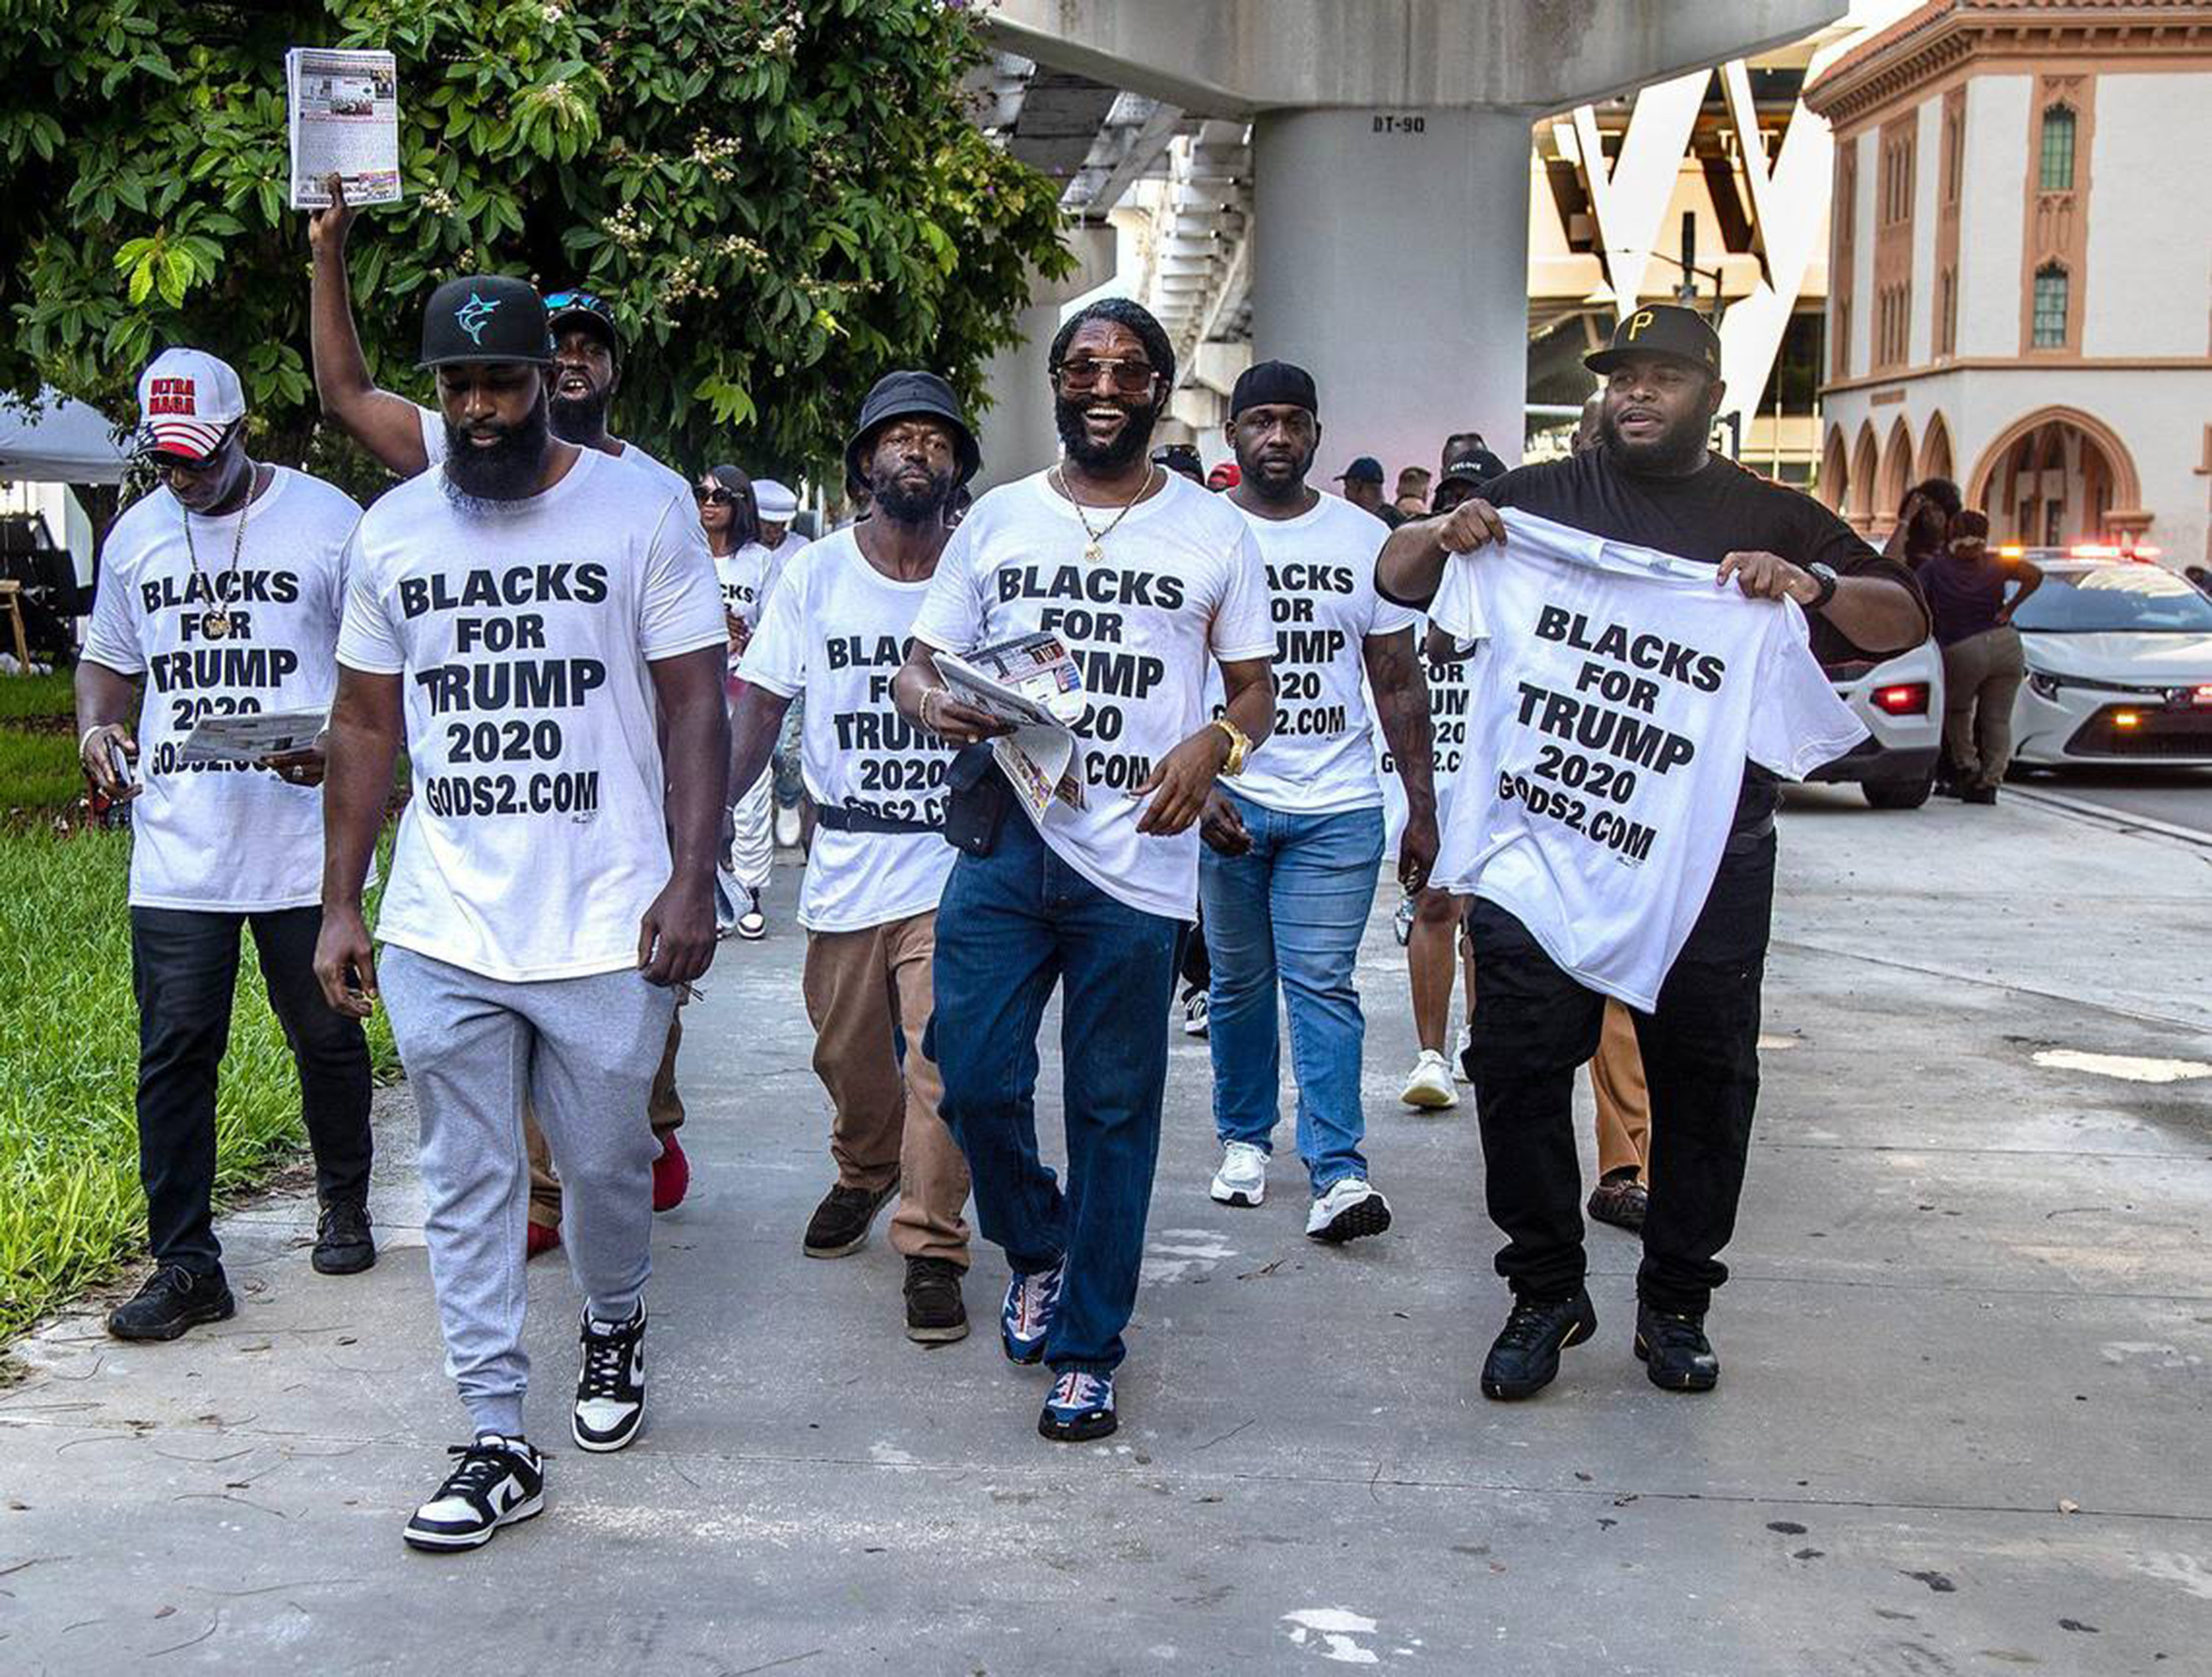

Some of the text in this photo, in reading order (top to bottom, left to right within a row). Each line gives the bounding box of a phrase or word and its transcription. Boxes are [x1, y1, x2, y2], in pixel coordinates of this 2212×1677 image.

[1373, 116, 1425, 133] DT-90
[1629, 310, 1654, 341] P
[141, 570, 299, 614] BLACKS
[400, 563, 608, 619] BLACKS
[998, 566, 1185, 610] BLACKS
[1265, 563, 1354, 594] ACKS
[181, 611, 251, 641] FOR
[1040, 608, 1124, 644] FOR
[1270, 597, 1314, 623] OR
[456, 614, 546, 653] FOR
[1272, 630, 1346, 664] UMP
[1534, 605, 1725, 692] BLACKS
[151, 649, 298, 693] TRUMP
[415, 659, 607, 717] TRUMP
[1576, 662, 1660, 715] FOR
[447, 720, 563, 763] 2020
[1070, 706, 1124, 742] 20
[1517, 681, 1694, 775] TRUMP
[426, 771, 599, 816] GODS2.COM
[860, 759, 947, 791] 2020
[1534, 745, 1635, 805] 2020
[1499, 771, 1657, 861] GODS2.COM
